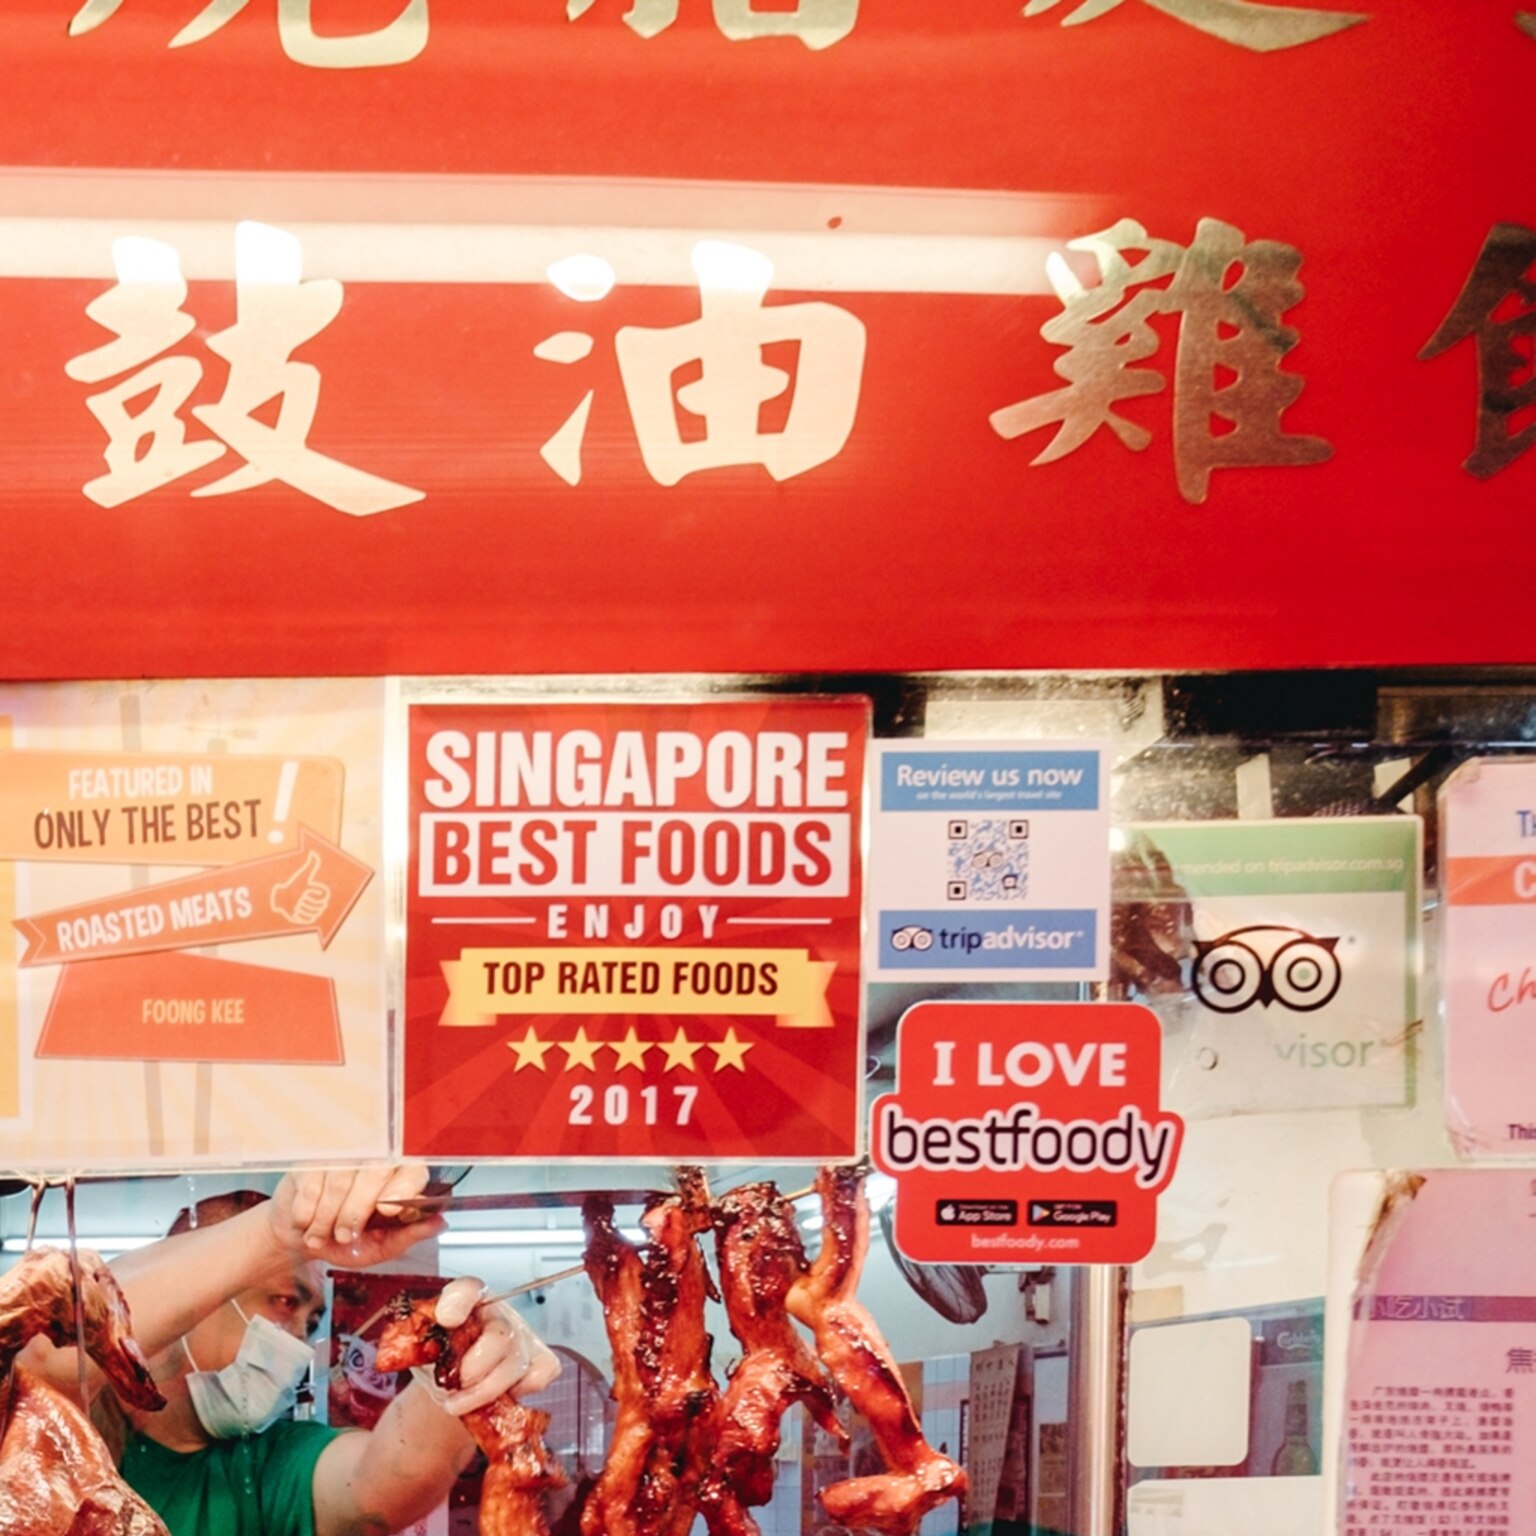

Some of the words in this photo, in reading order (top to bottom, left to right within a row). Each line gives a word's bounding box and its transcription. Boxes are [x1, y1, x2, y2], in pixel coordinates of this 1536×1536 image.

[68, 766, 182, 800] FEATURED
[190, 765, 212, 795] IN
[424, 730, 849, 809] SINGAPORE
[897, 764, 985, 787] Review
[992, 768, 1020, 786] us
[1028, 767, 1083, 786] now
[34, 809, 110, 849] ONLY
[121, 804, 176, 845] THE
[432, 820, 597, 886] BEST
[621, 819, 832, 886] FOODS
[56, 904, 164, 952] ROASTED
[168, 886, 252, 931] MEATS
[548, 904, 719, 939] ENJOY
[940, 926, 1073, 954] tripadvisor
[483, 961, 545, 996] TOP
[558, 961, 660, 996] RATED
[672, 962, 778, 996] FOODS
[142, 999, 206, 1024] FOONG
[211, 999, 245, 1024] KEE
[933, 1041, 956, 1086] I
[977, 1041, 1127, 1087] LOVE
[569, 1084, 699, 1125] 2017
[888, 1109, 1169, 1182] bestfoody
[958, 1211, 980, 1222] App
[983, 1211, 1012, 1221] Store
[1052, 1211, 1089, 1223] Google
[1090, 1212, 1111, 1222] Play
[971, 1233, 1079, 1251] bestfoody.com
